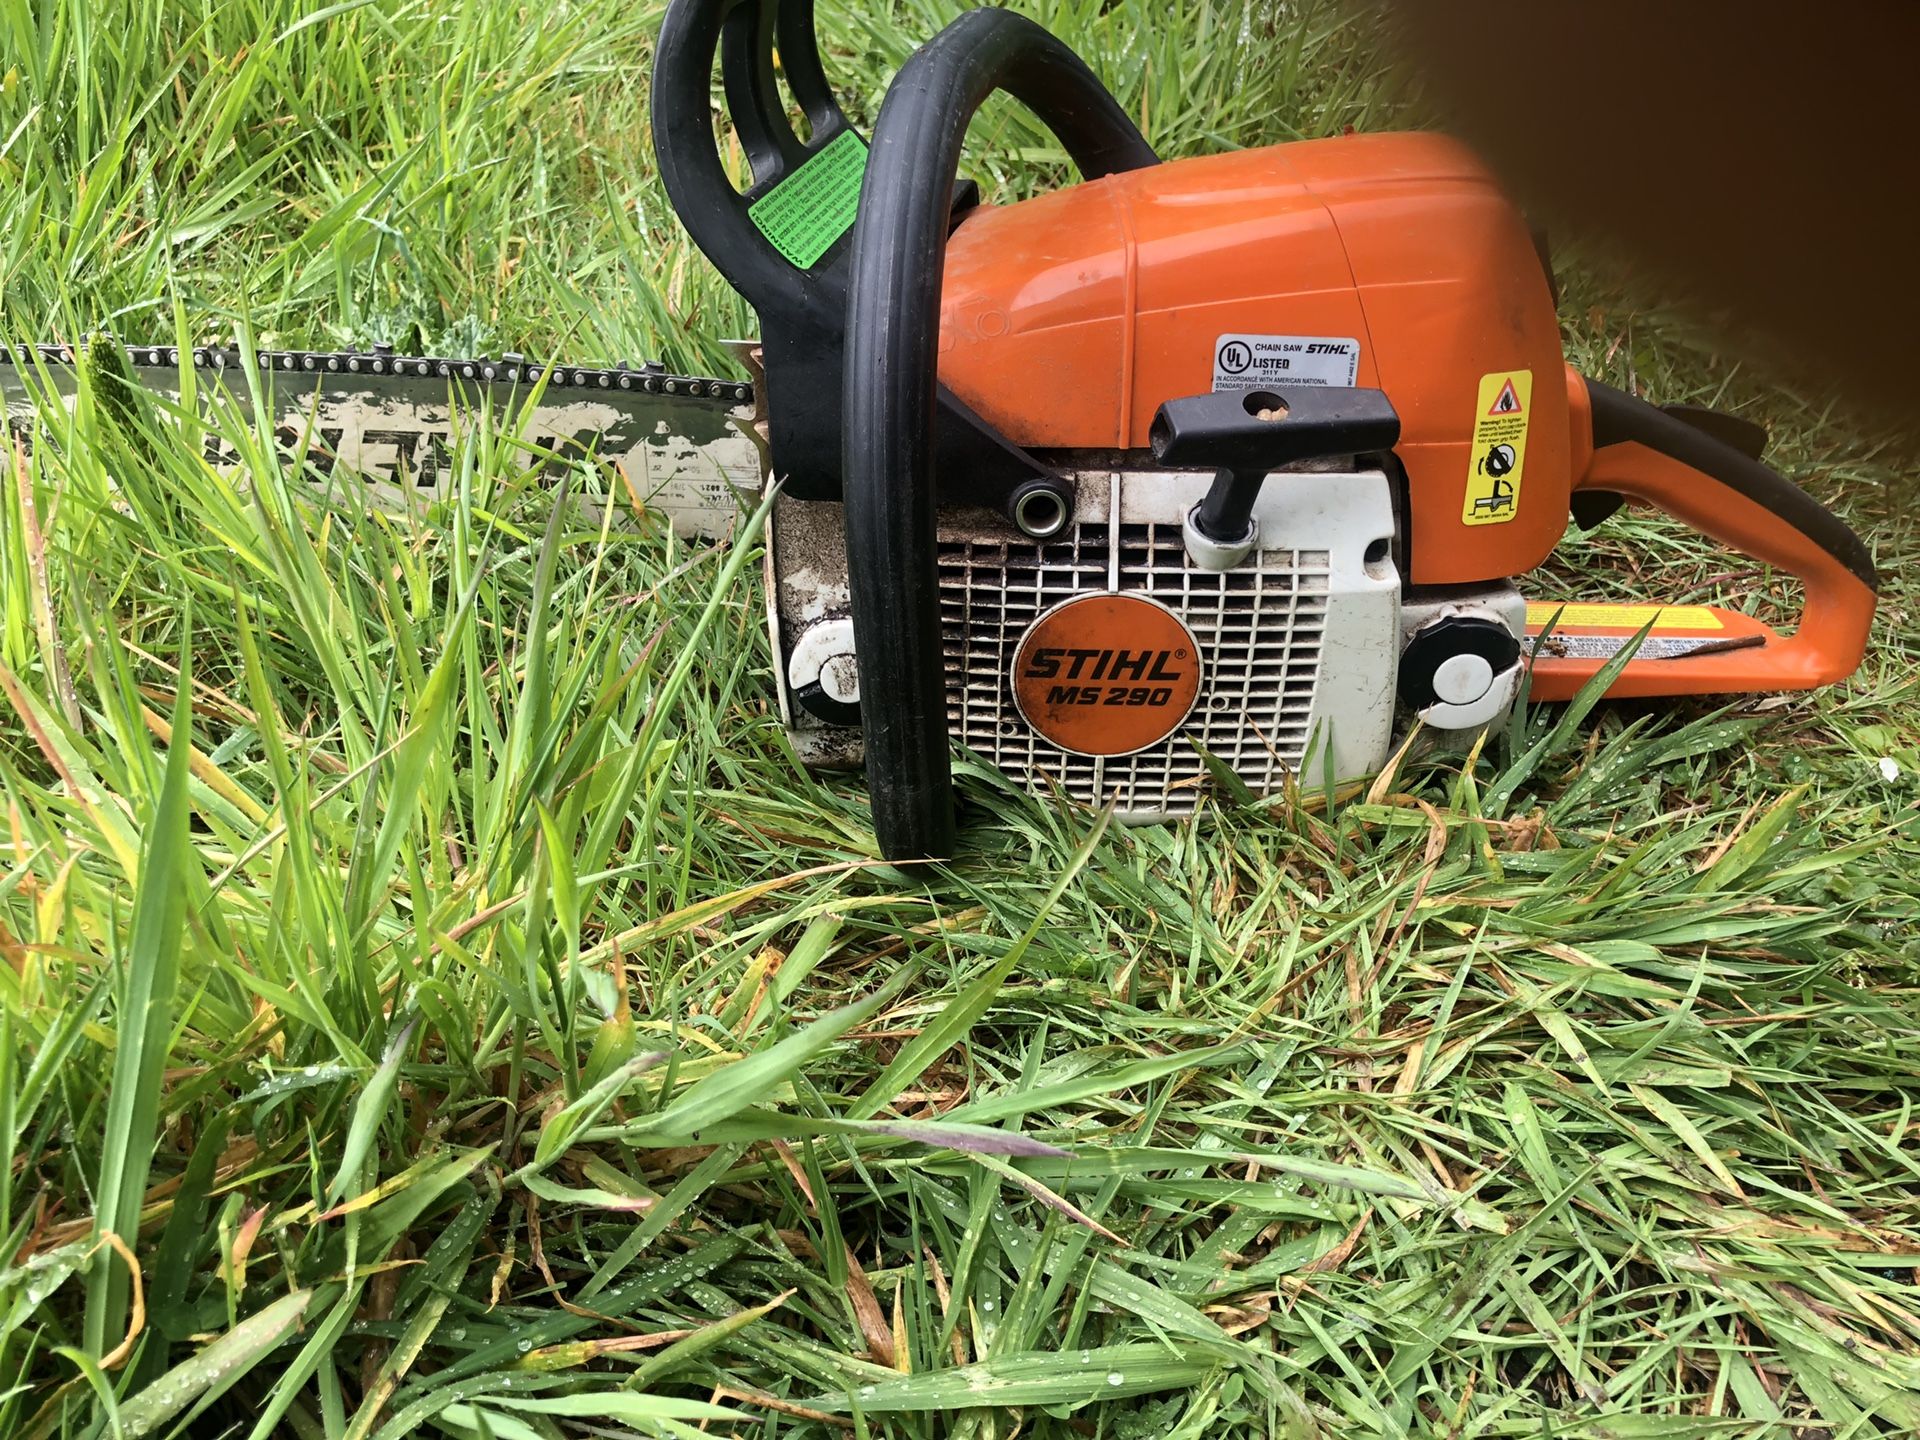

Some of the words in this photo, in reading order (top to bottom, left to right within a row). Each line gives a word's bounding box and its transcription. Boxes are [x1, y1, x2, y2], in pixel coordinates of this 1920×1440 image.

[1254, 343, 1282, 352] CHAIN
[1283, 344, 1302, 352] SAW
[1253, 358, 1290, 369] LISTED
[1045, 686, 1102, 706] MS
[1103, 687, 1173, 706] 290
